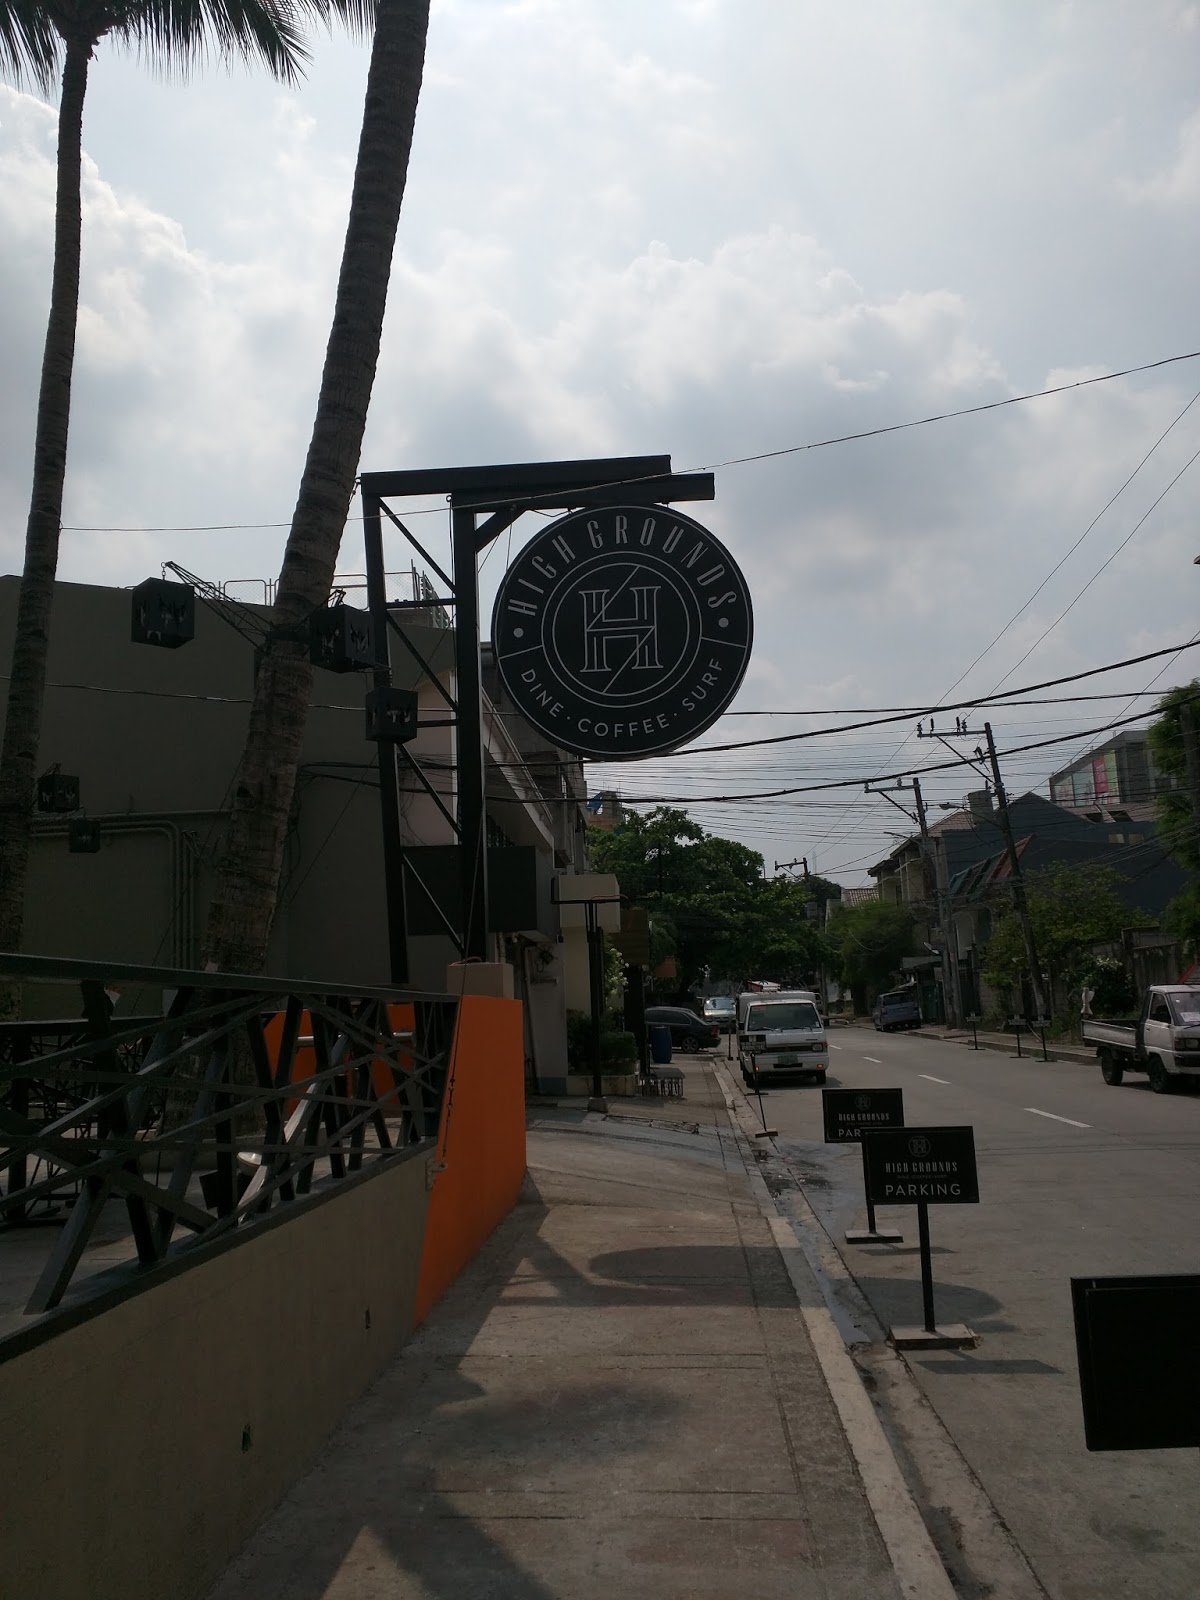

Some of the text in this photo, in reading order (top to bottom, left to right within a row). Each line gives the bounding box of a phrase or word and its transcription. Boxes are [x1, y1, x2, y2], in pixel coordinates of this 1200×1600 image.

[507, 515, 737, 617] HIGH GROUNDS
[520, 658, 724, 738] DINE COFFEE SURF
[838, 1128, 862, 1137] PAR
[885, 1161, 958, 1173] HIGH GROUNDS
[885, 1183, 961, 1196] PARKING
